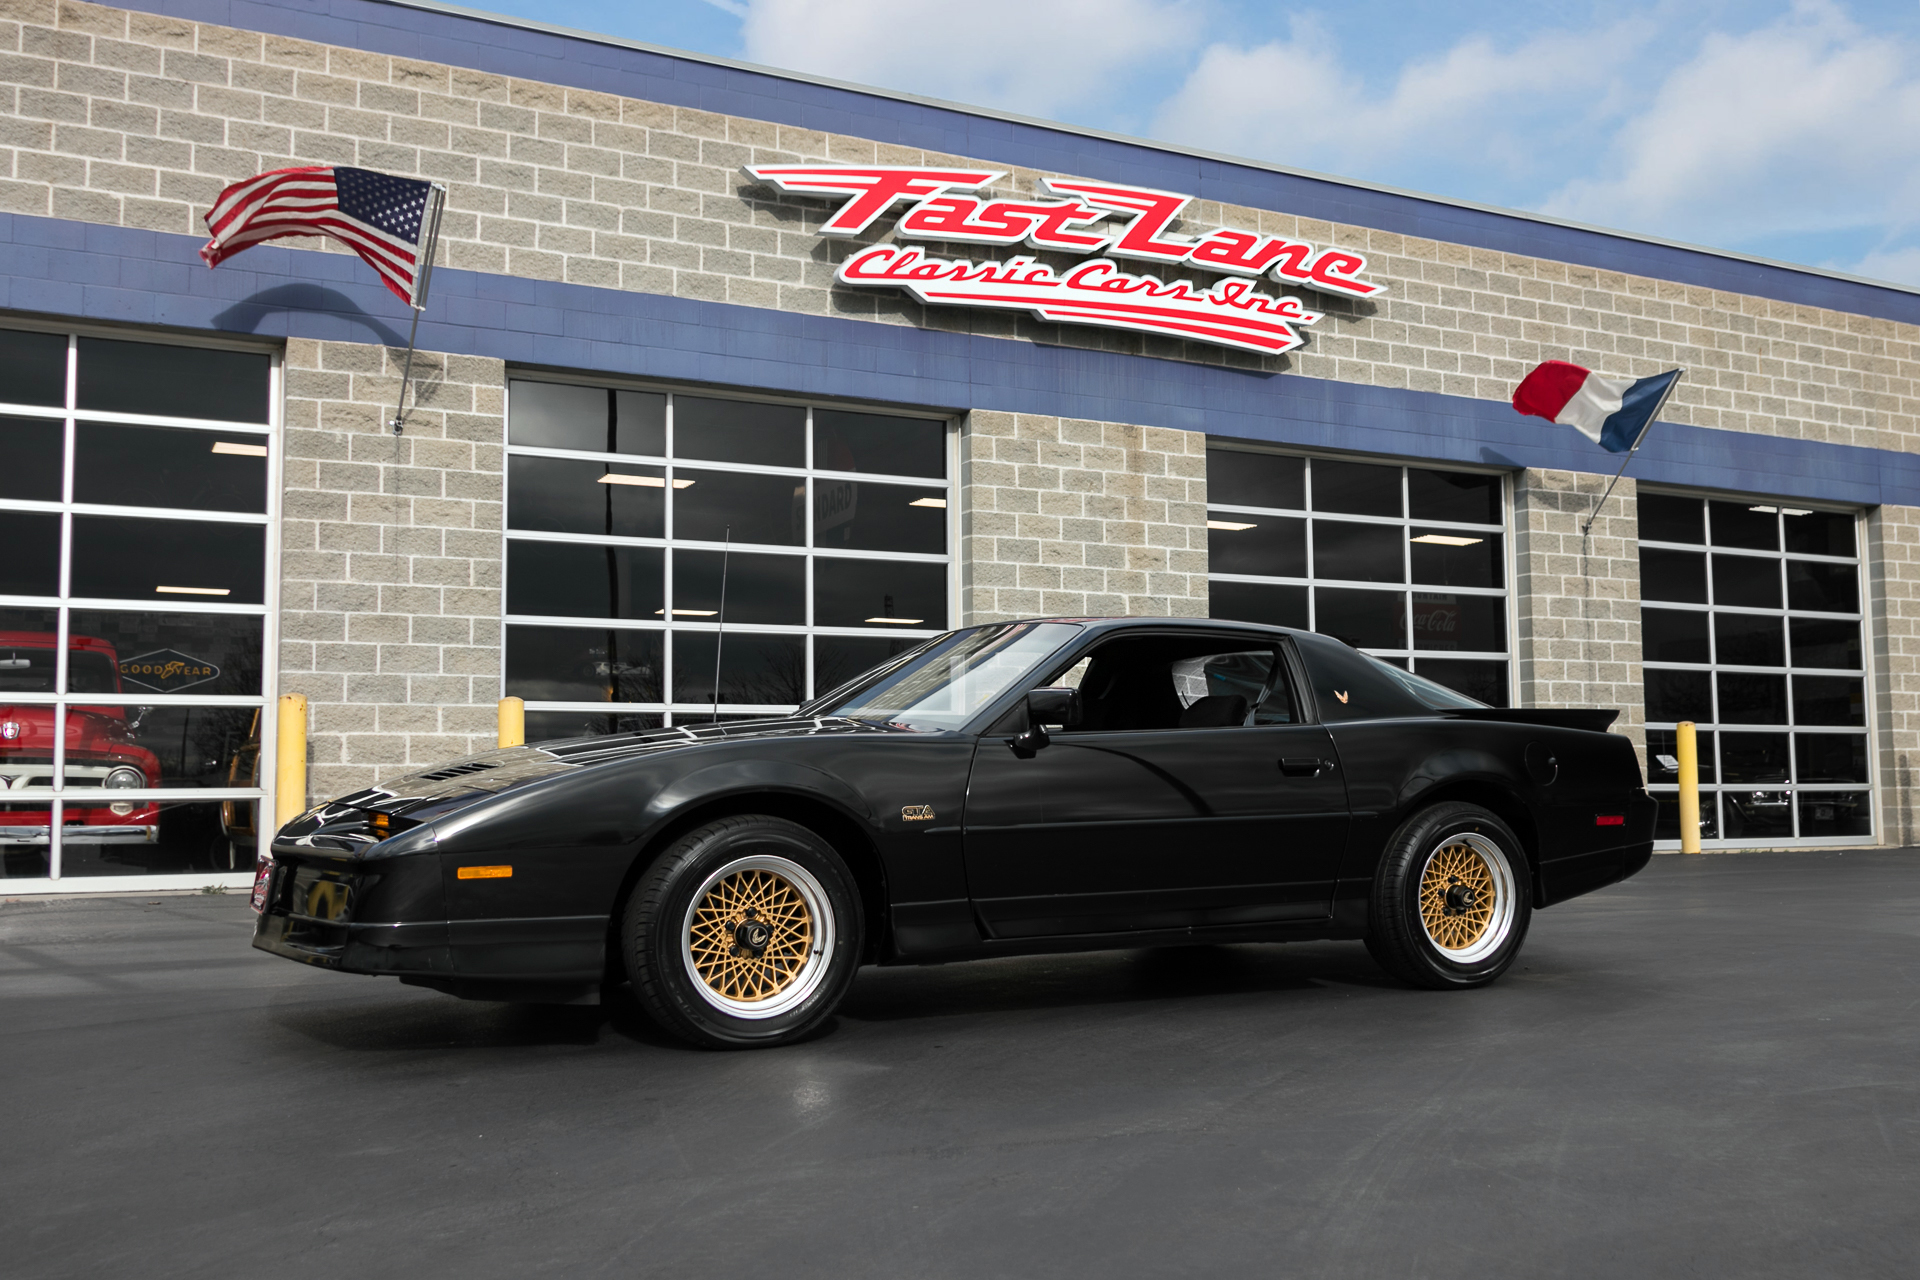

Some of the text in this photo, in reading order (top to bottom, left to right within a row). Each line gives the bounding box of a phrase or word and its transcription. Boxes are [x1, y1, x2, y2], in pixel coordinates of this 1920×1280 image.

[752, 168, 1379, 294] Fast Lane
[844, 249, 1314, 321] Classic Cars Inc.
[796, 482, 852, 530] SNDARD
[1399, 610, 1458, 632] Cca-Cola
